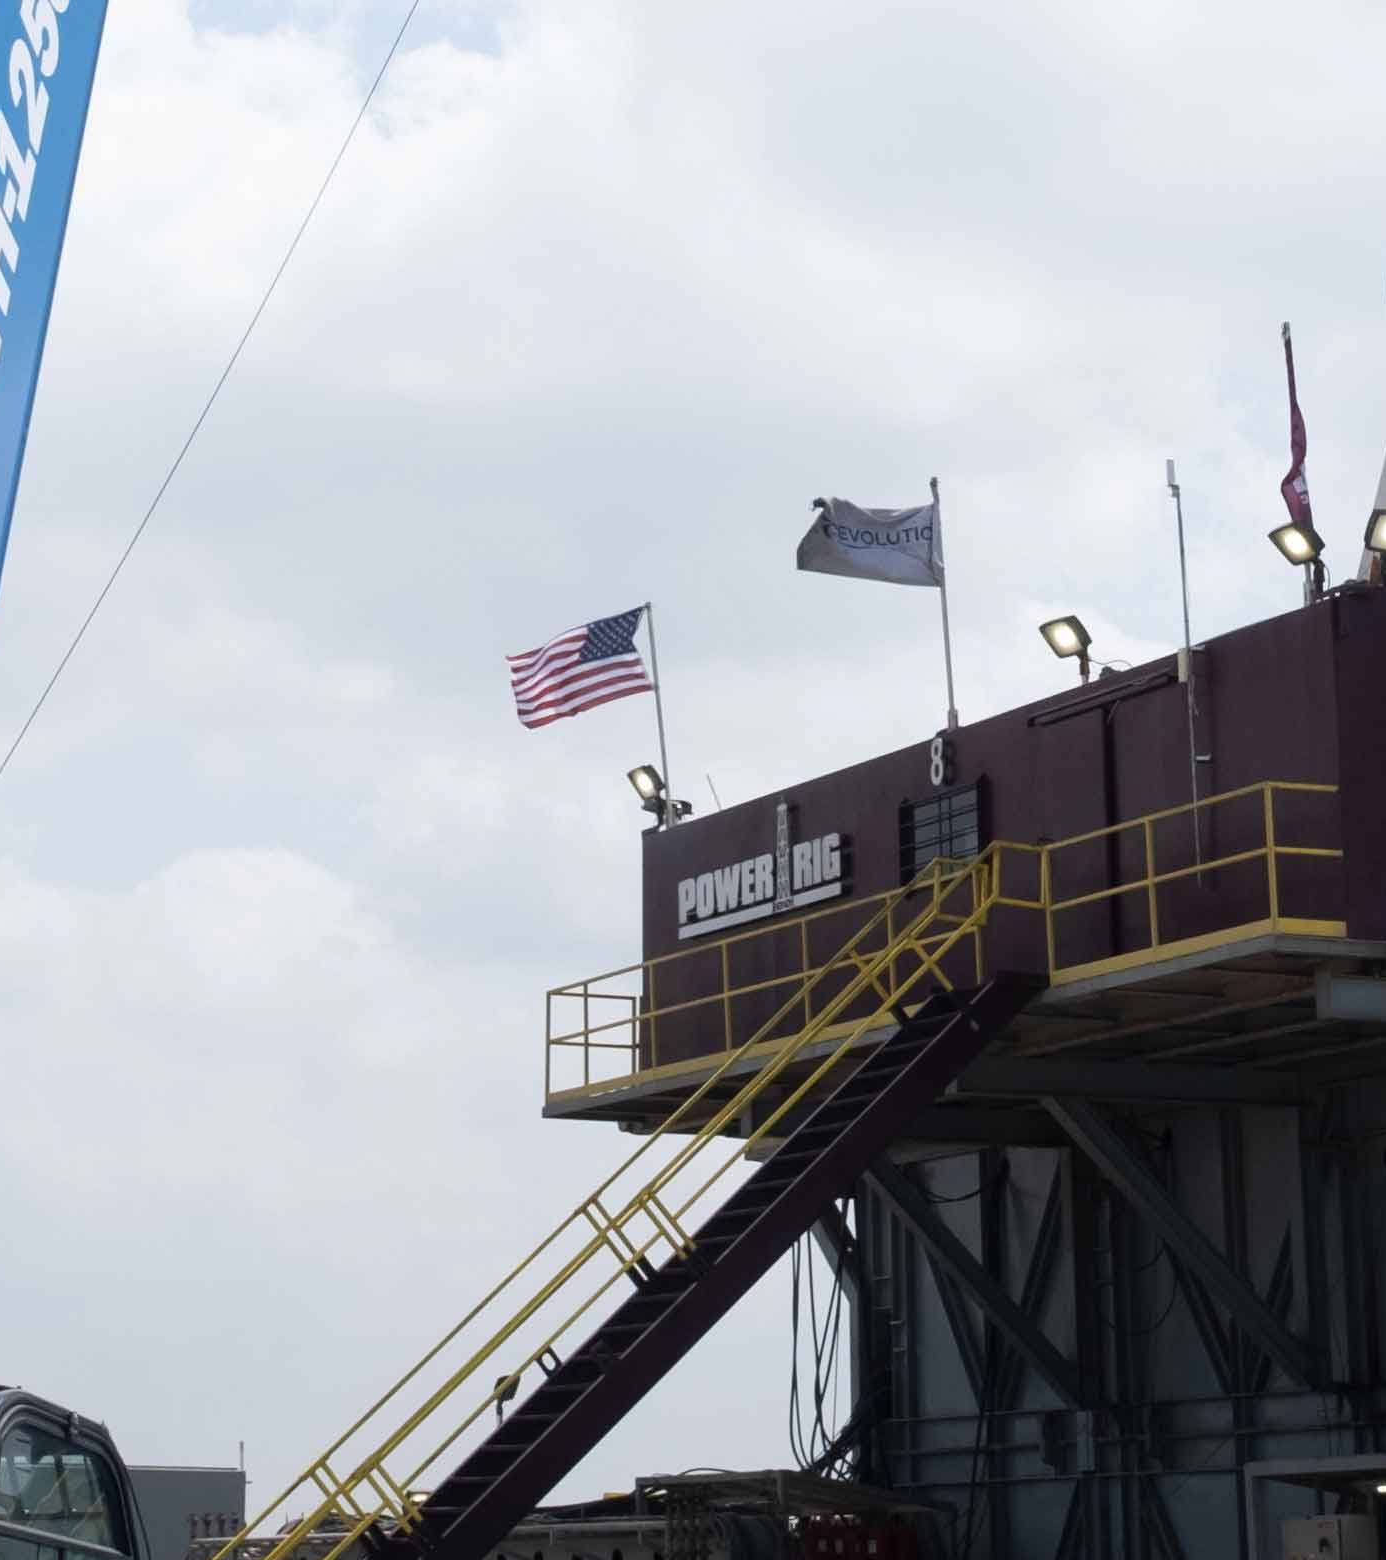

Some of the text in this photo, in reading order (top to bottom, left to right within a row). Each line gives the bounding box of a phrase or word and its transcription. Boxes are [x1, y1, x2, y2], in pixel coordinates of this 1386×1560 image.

[930, 736, 944, 787] 8
[678, 832, 842, 925] POWER RIG
